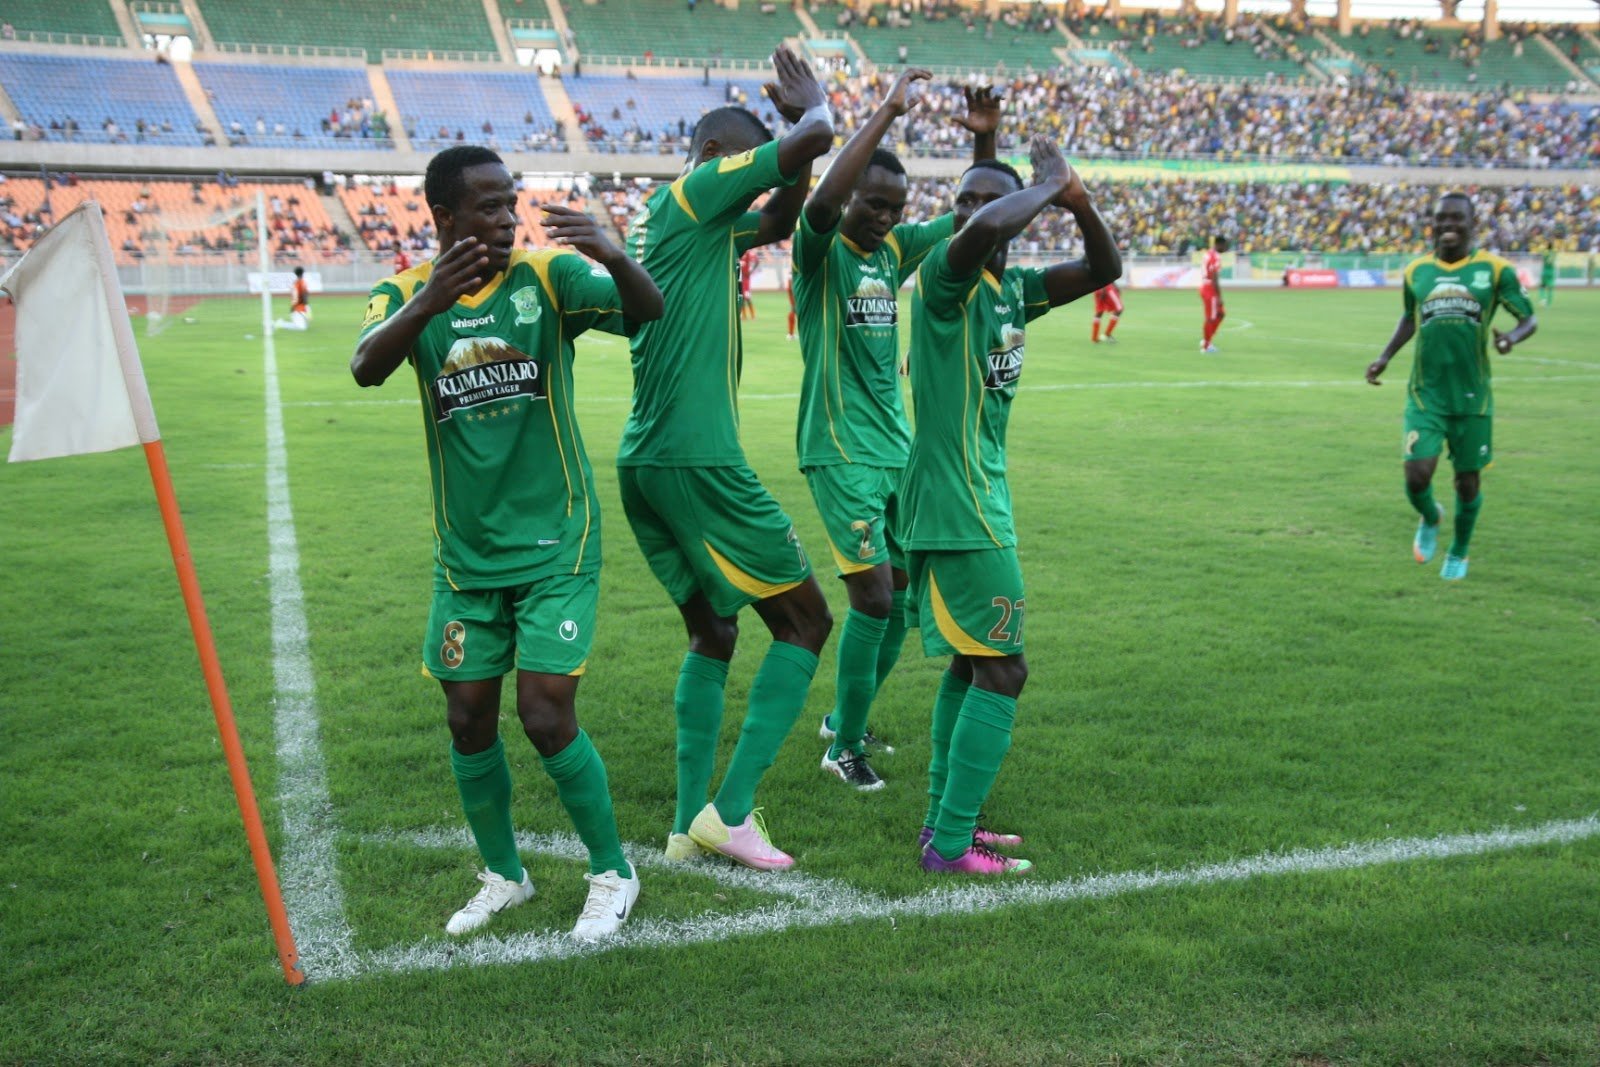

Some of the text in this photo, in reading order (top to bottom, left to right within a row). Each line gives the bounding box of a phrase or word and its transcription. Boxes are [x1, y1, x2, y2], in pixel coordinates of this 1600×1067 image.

[451, 314, 496, 329] uhlsport
[437, 361, 539, 397] KLIMANJARO
[458, 384, 520, 405] PREMIUM LAGER
[440, 620, 466, 669] 8
